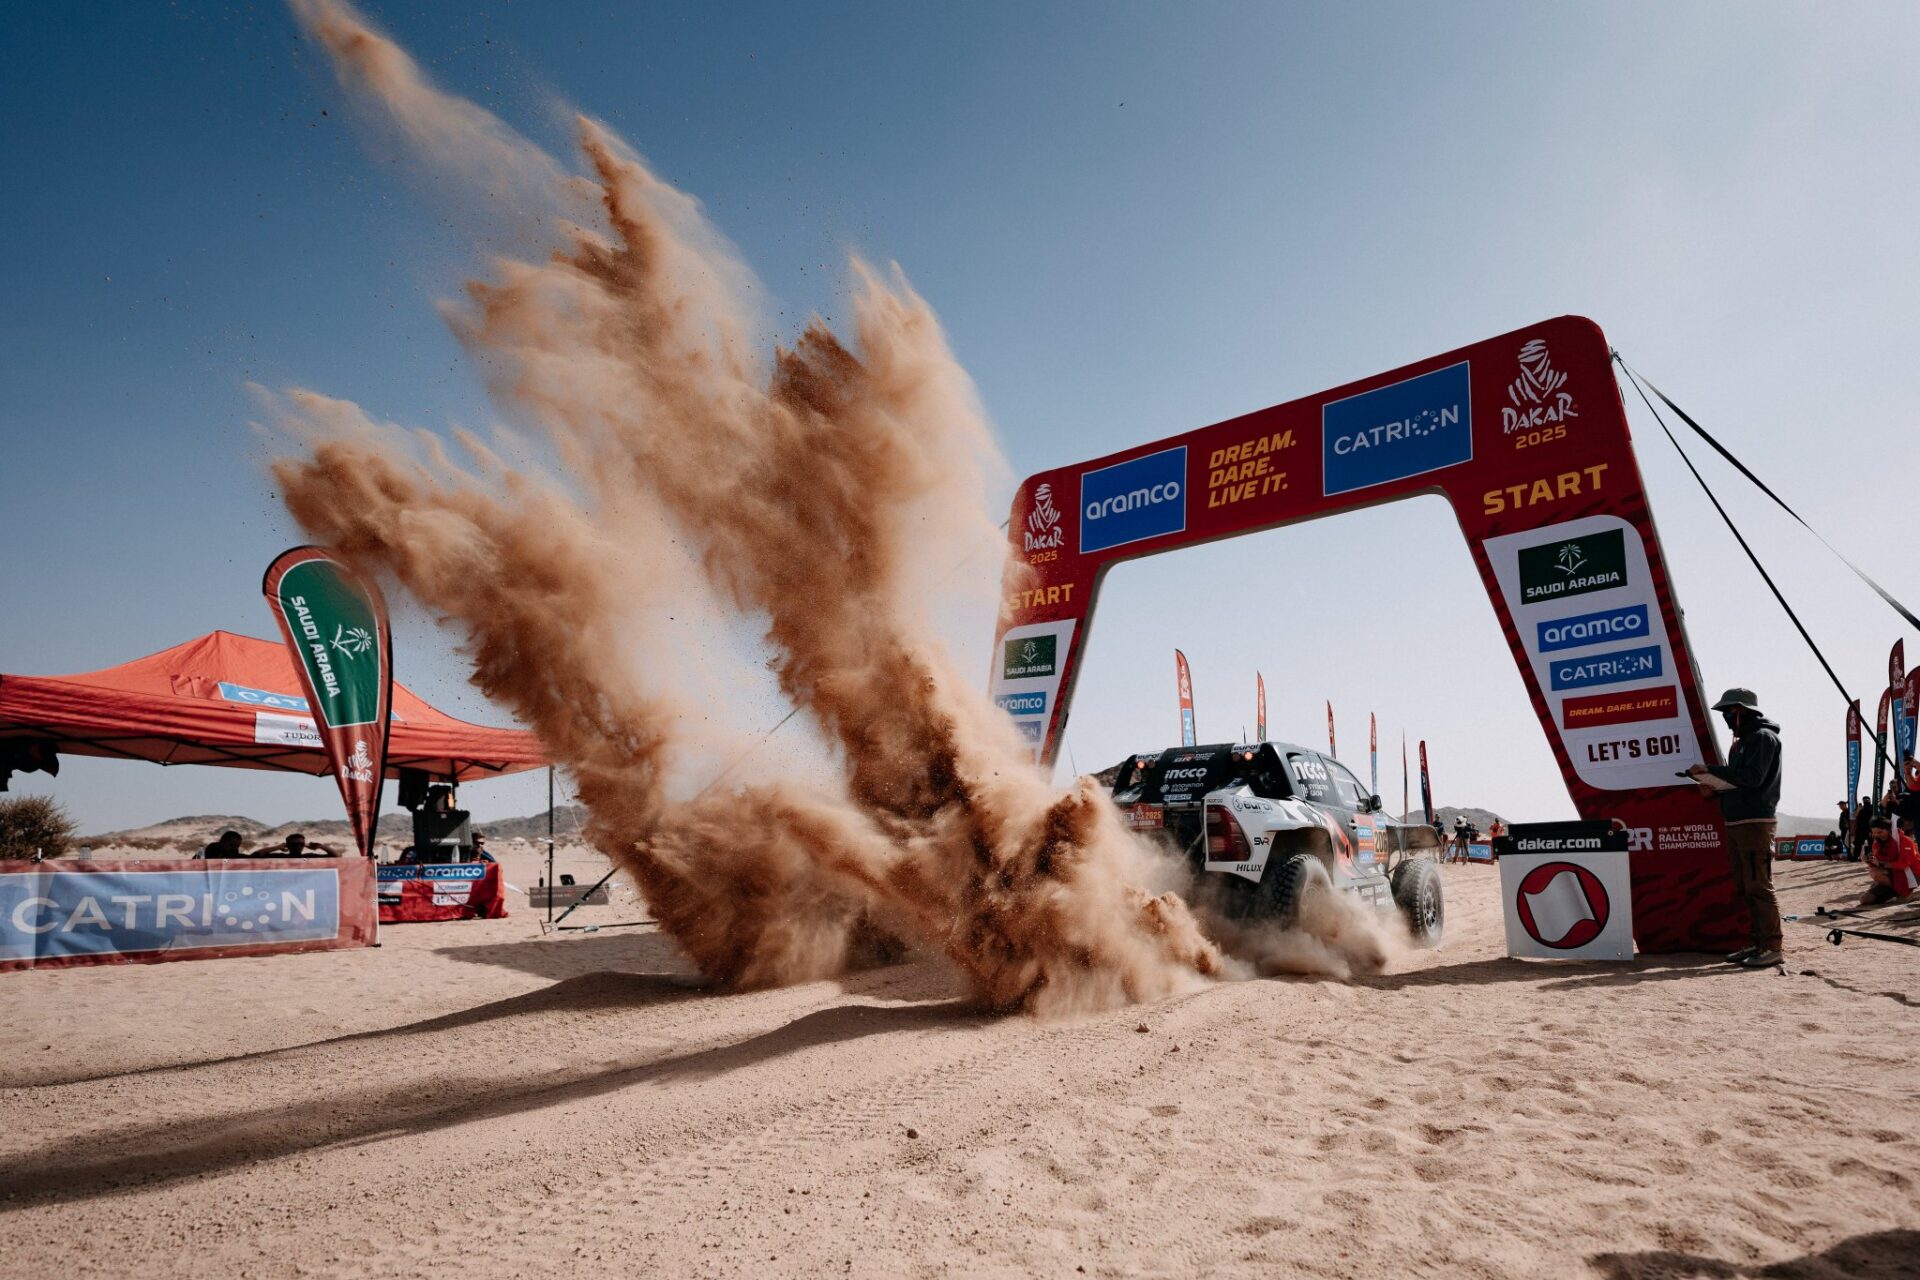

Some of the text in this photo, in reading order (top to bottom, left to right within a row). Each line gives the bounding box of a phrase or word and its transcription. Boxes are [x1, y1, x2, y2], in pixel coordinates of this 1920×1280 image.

[1502, 392, 1578, 434] DAKAR
[1334, 404, 1458, 455] CATRION
[1515, 425, 1567, 449] 2025
[1209, 429, 1297, 469] DREAM.
[1209, 456, 1275, 488] DARE.
[1086, 481, 1180, 520] aramco
[1208, 472, 1288, 508] LIVE IT.
[1484, 464, 1608, 515] START
[1024, 526, 1064, 551] DAKAR
[1030, 550, 1058, 565] 2025
[1009, 583, 1074, 611] START
[1526, 571, 1620, 598] SAUDI ARABIA
[1544, 614, 1641, 643] aramco
[291, 595, 340, 698] SAUDI ARABIA
[1006, 664, 1052, 675] SAUDI ARABIA
[1559, 655, 1653, 682] CATRION
[1569, 698, 1671, 717] DREAM. DARE. LIVE IT.
[284, 732, 321, 741] TUDOR
[1588, 734, 1681, 763] LET'S GO!
[342, 764, 373, 784] DAKAR
[1658, 832, 1718, 842] RALLY-RAID
[1684, 824, 1713, 832] WORLD
[1517, 837, 1601, 850] dakar.com
[1659, 841, 1721, 850] CHAMPIONSHIP
[424, 866, 482, 878] aramco
[1236, 864, 1262, 872] HILUX
[12, 887, 315, 934] CATRION
